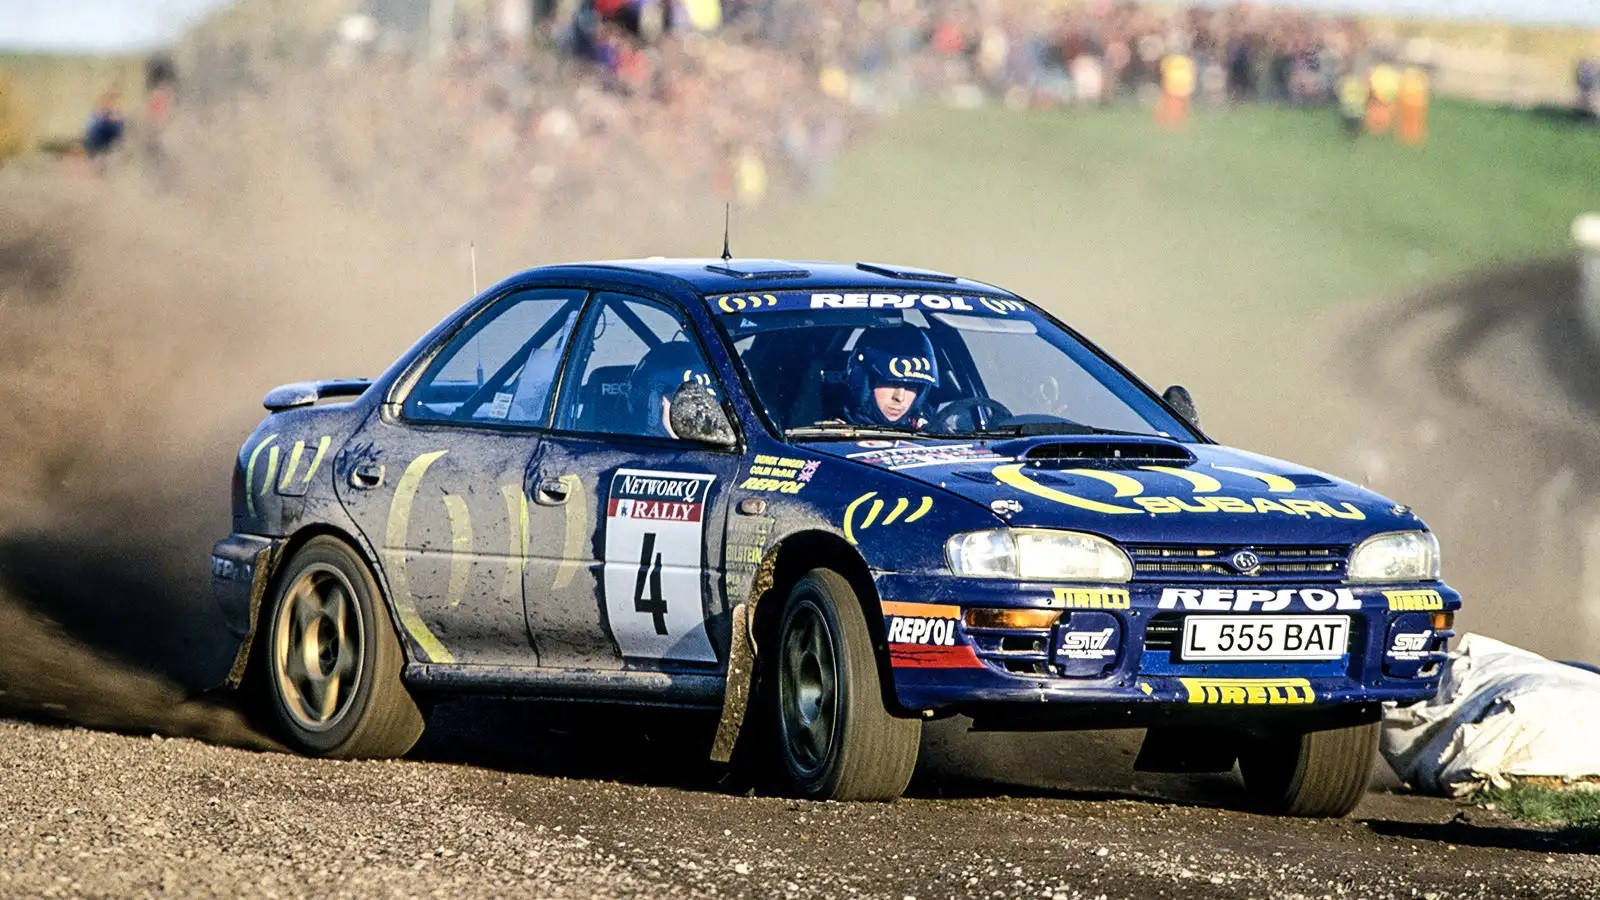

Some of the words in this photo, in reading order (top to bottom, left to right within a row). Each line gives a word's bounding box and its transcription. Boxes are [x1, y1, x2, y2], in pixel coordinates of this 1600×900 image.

[810, 293, 973, 311] REPSOL
[739, 477, 805, 494] REPSOL
[633, 500, 695, 521] RALLY
[1133, 496, 1366, 521] SUBARU
[634, 532, 669, 635] 4
[1052, 587, 1130, 610] PIRELLI
[1157, 588, 1362, 612] REPSOL
[1381, 589, 1444, 611] PIRELLI
[888, 617, 956, 646] REPSOL
[1190, 624, 1206, 651] L
[1217, 624, 1273, 651] 555
[1283, 623, 1342, 651] BAT
[1179, 677, 1316, 704] PIRELLI
